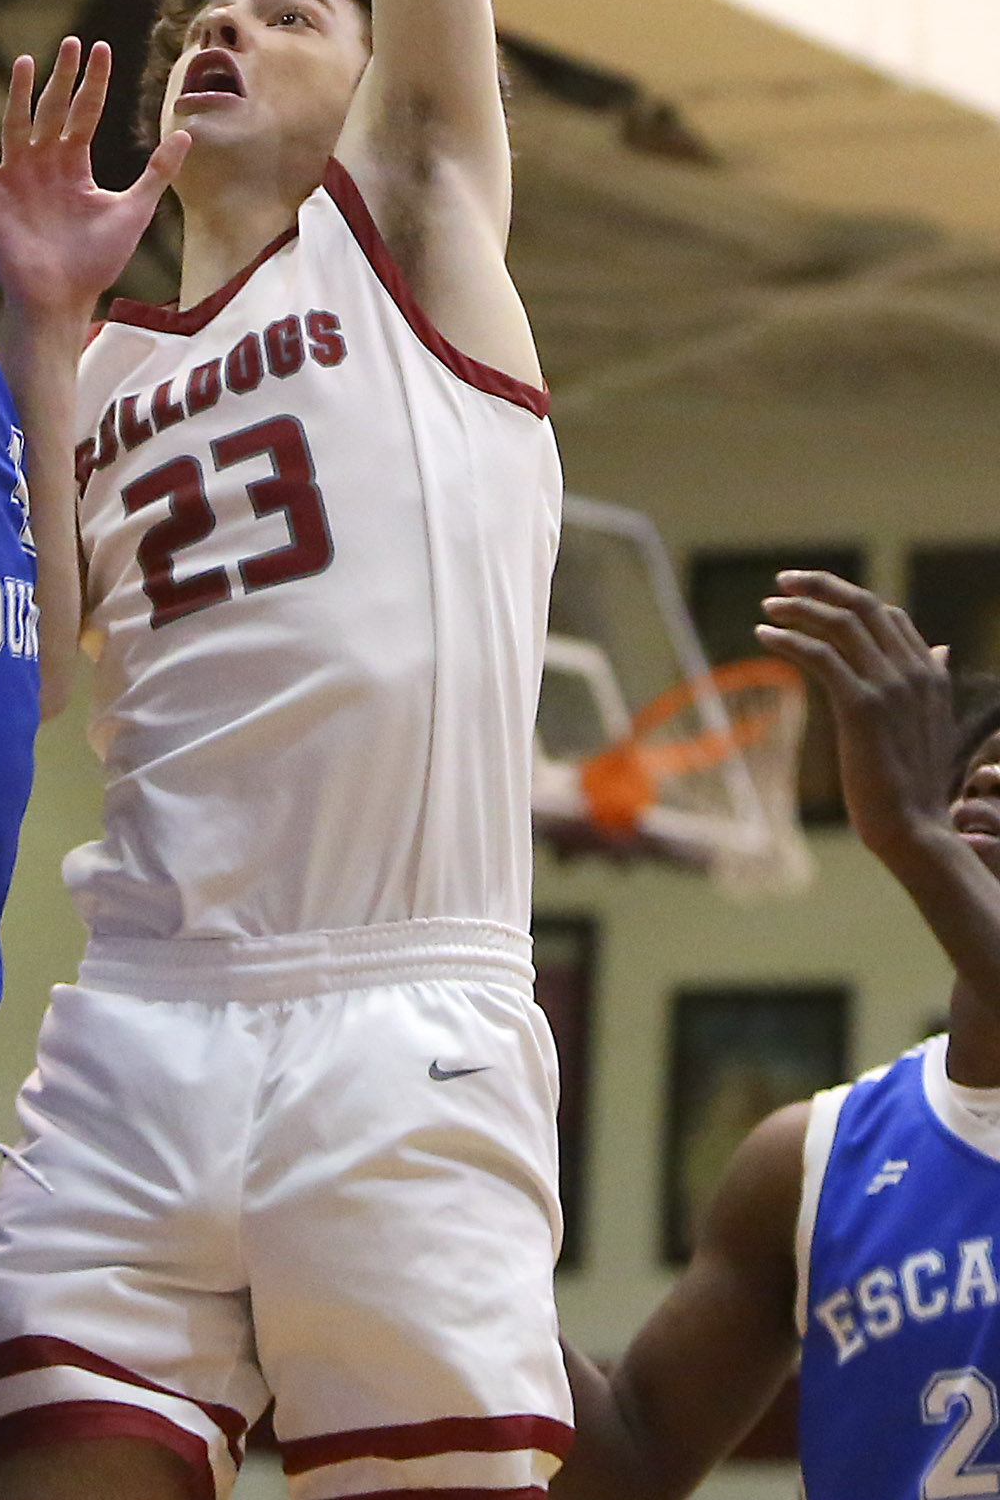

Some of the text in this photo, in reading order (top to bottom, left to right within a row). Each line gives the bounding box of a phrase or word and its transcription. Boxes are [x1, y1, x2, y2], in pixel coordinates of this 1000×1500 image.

[120, 413, 335, 631] 23
[815, 1236, 1000, 1367] ESCA
[919, 1364, 1000, 1500] 2
